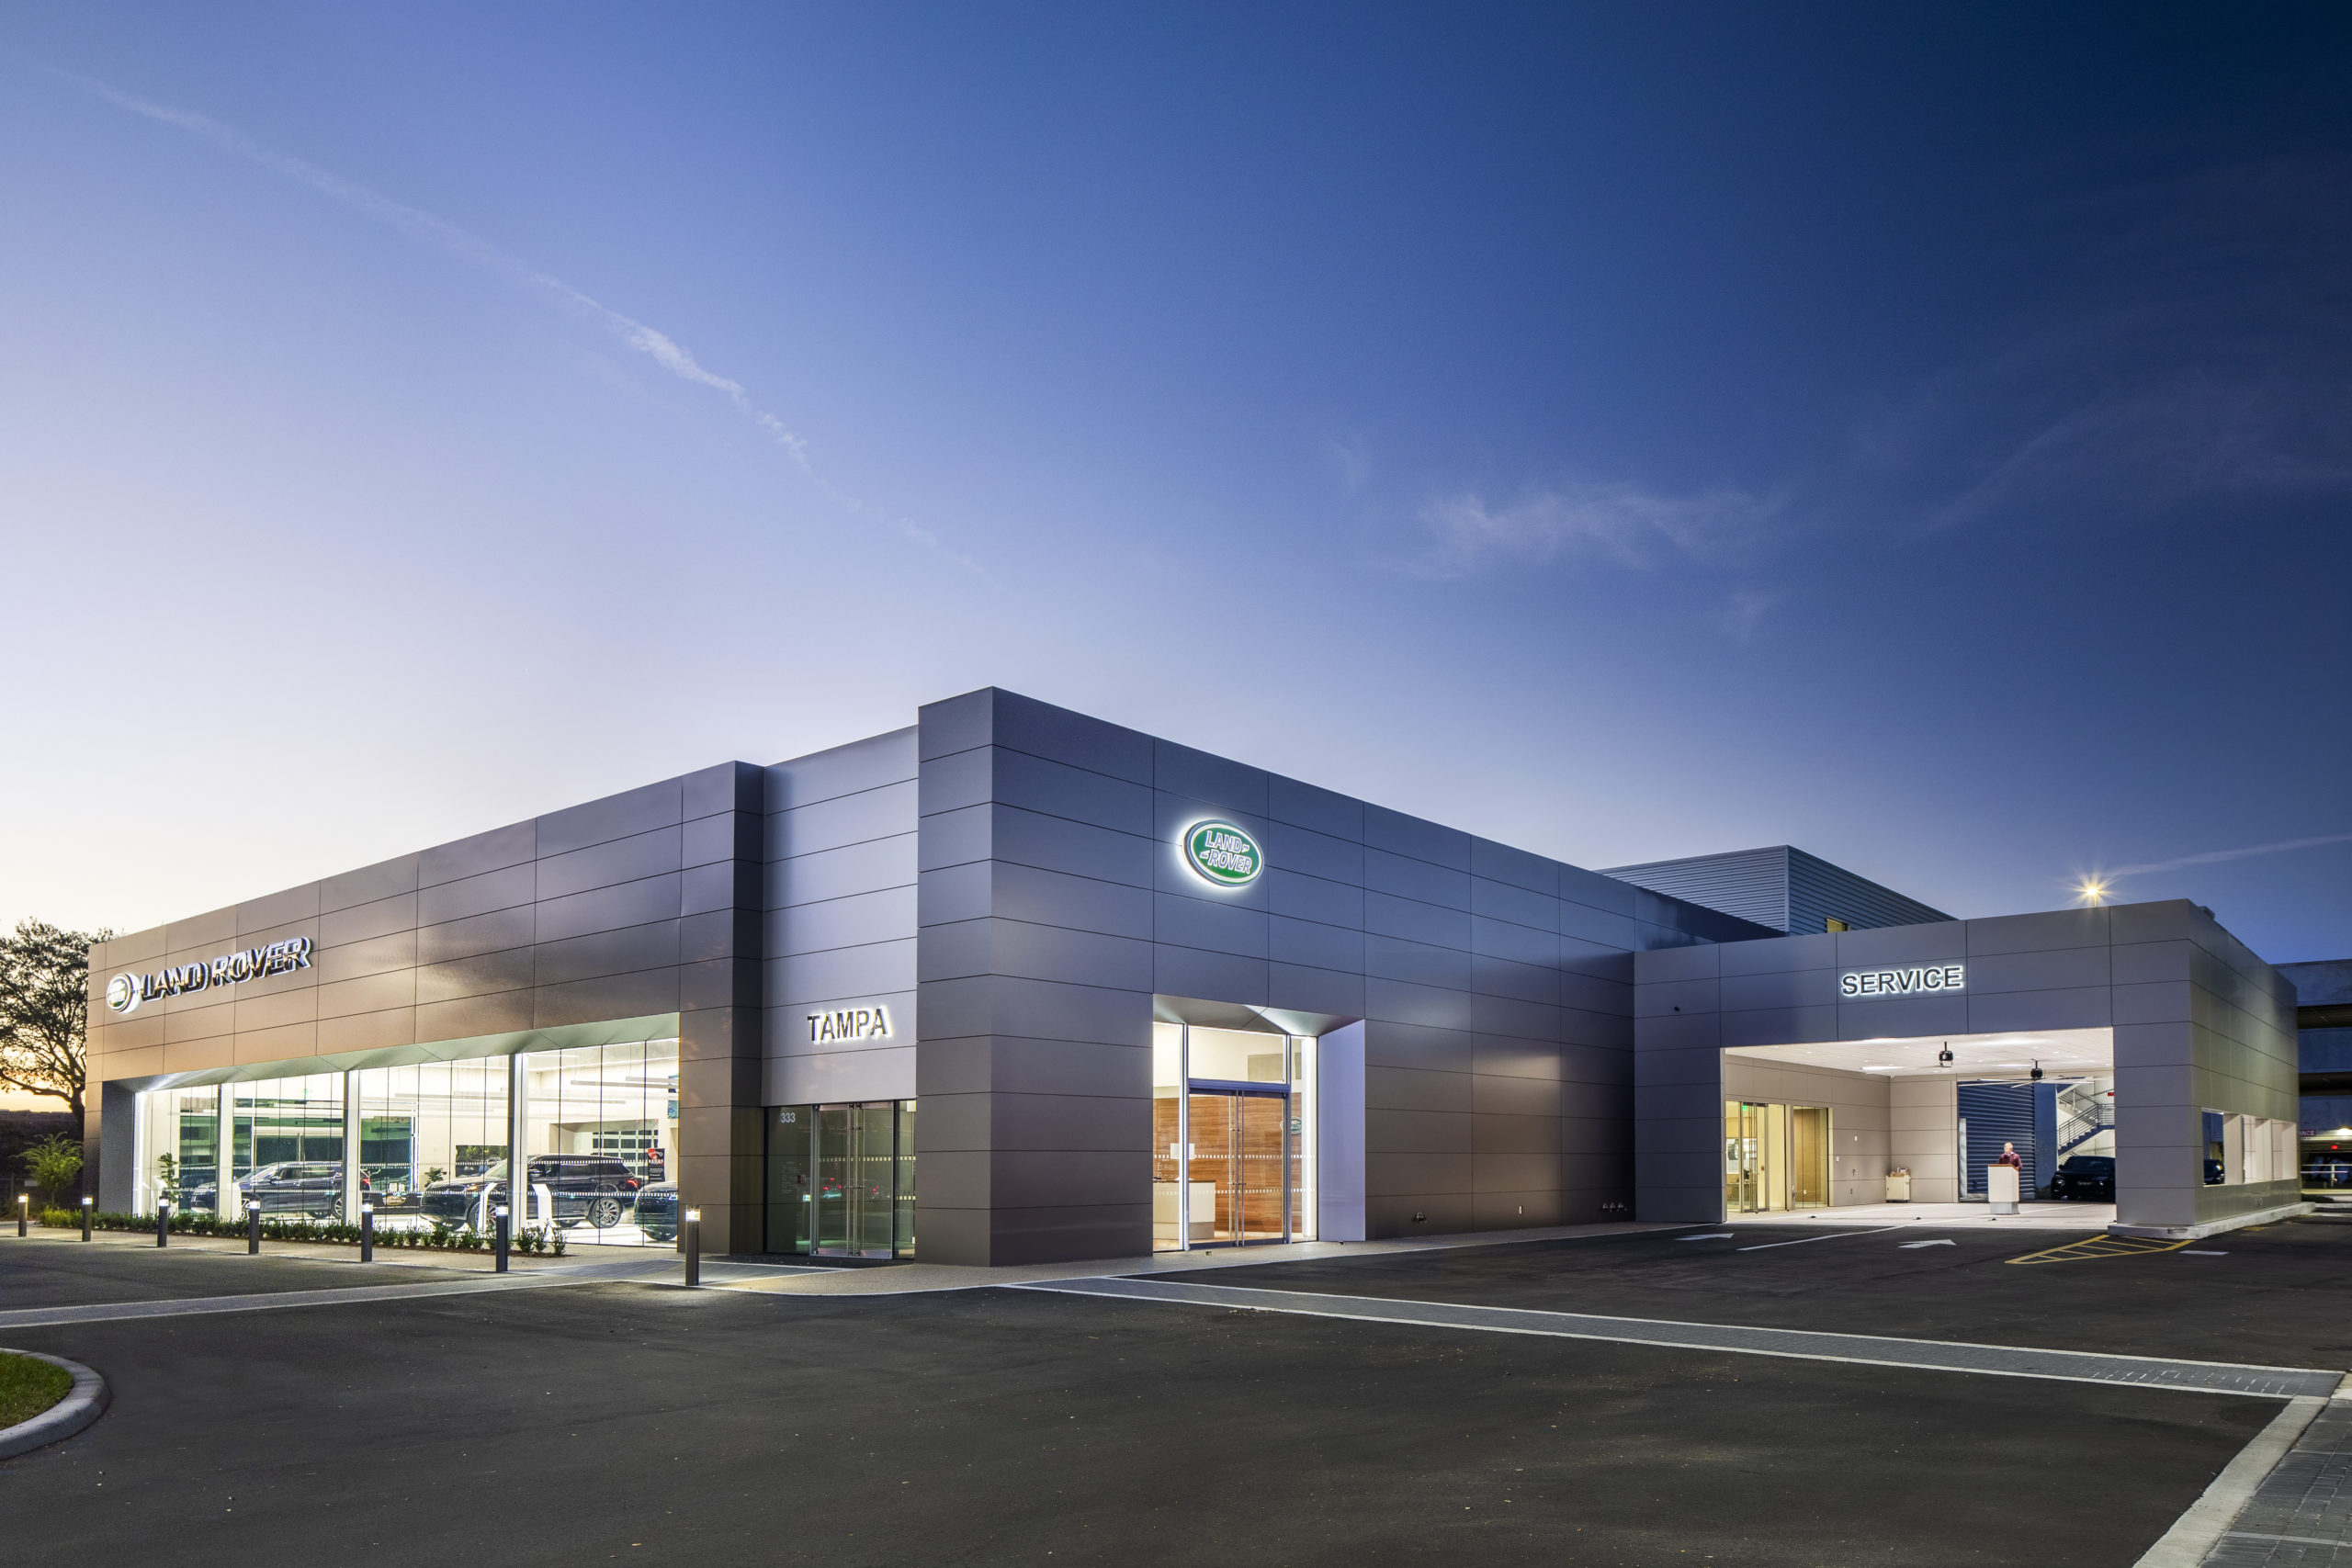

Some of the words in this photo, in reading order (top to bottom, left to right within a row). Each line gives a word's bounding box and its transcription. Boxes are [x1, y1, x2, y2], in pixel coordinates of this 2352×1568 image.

[1205, 829, 1243, 854] LAND
[1207, 848, 1253, 874] ROVER
[141, 962, 210, 1002] LAND
[211, 937, 312, 987] ROVER
[1841, 965, 1963, 996] SERVICE
[807, 1007, 891, 1043] TAMPA
[780, 1111, 796, 1123] 333
